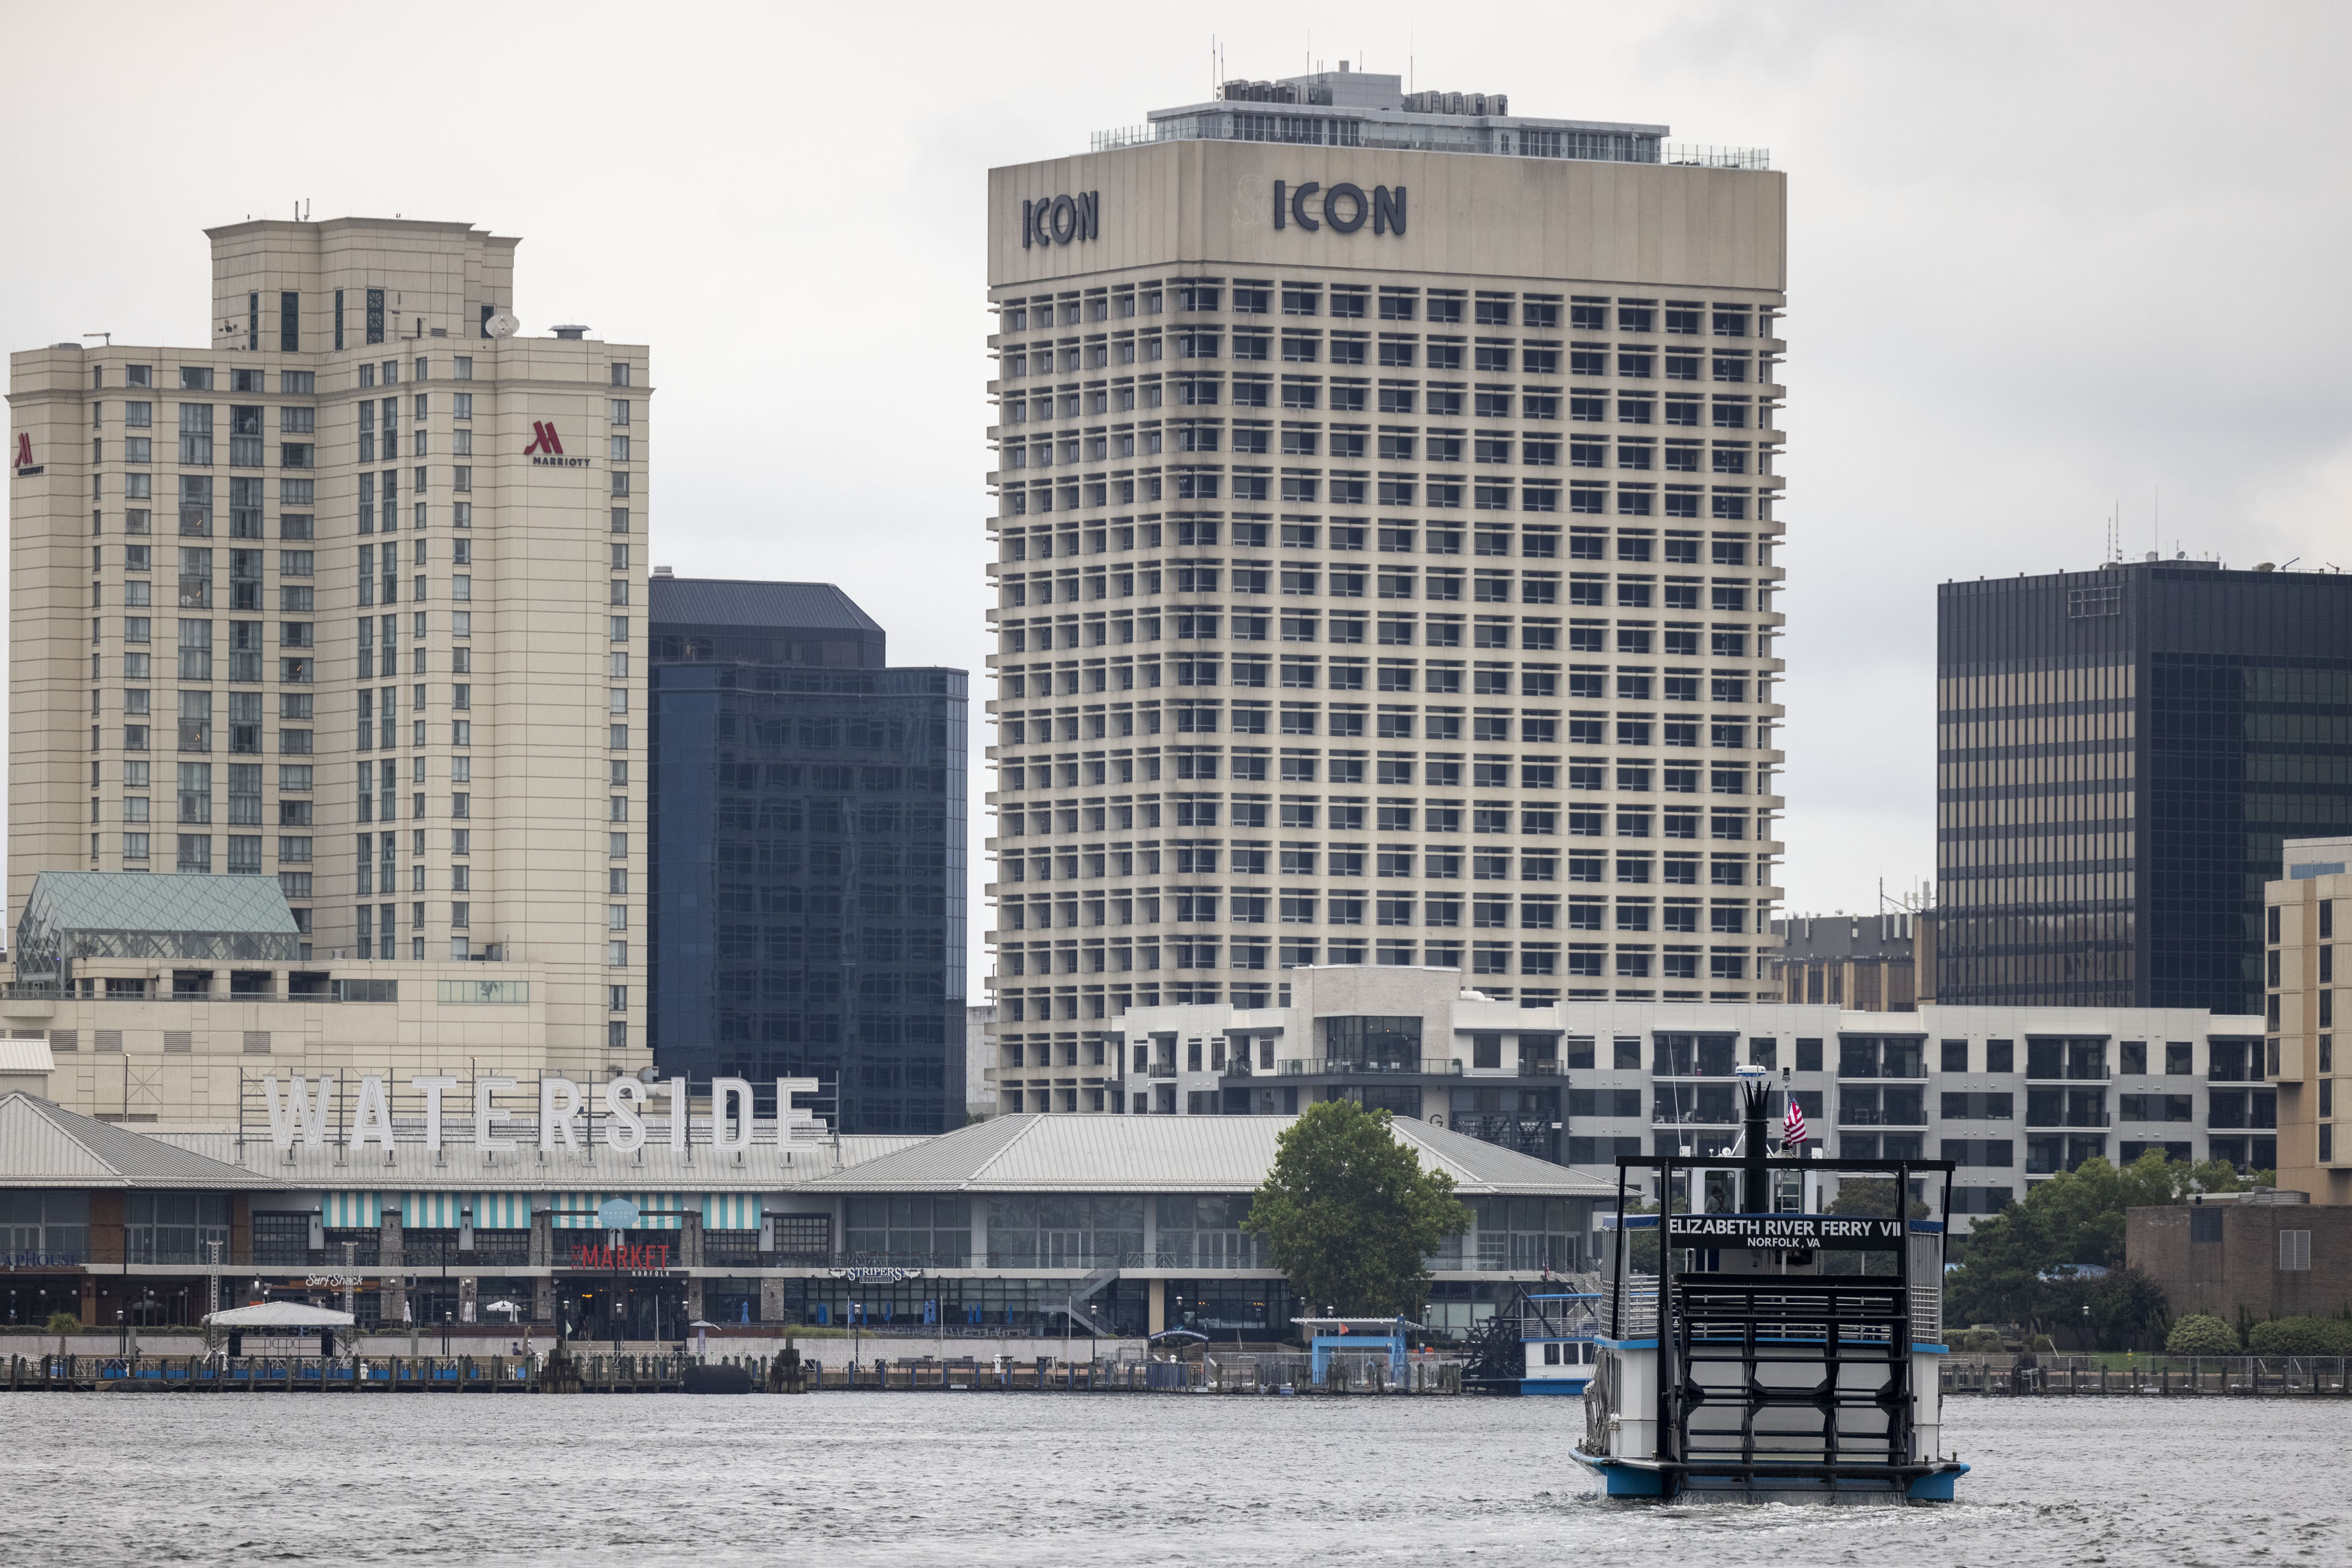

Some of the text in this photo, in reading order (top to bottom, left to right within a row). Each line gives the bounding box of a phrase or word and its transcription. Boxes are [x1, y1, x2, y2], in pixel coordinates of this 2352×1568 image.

[1274, 180, 1407, 235] ICON
[1022, 191, 1098, 248] ICON
[533, 456, 591, 466] MARRIOTT
[263, 1075, 819, 1153] WATERSIDE
[1669, 1219, 1901, 1237] ELIZABETH RIVER FERRY VII
[1807, 1238, 1821, 1247] VA
[583, 1245, 670, 1270] MARKET
[305, 1273, 332, 1287] Surf
[848, 1267, 902, 1281] STRIPERS
[1193, 1332, 1208, 1340] NORFOLK
